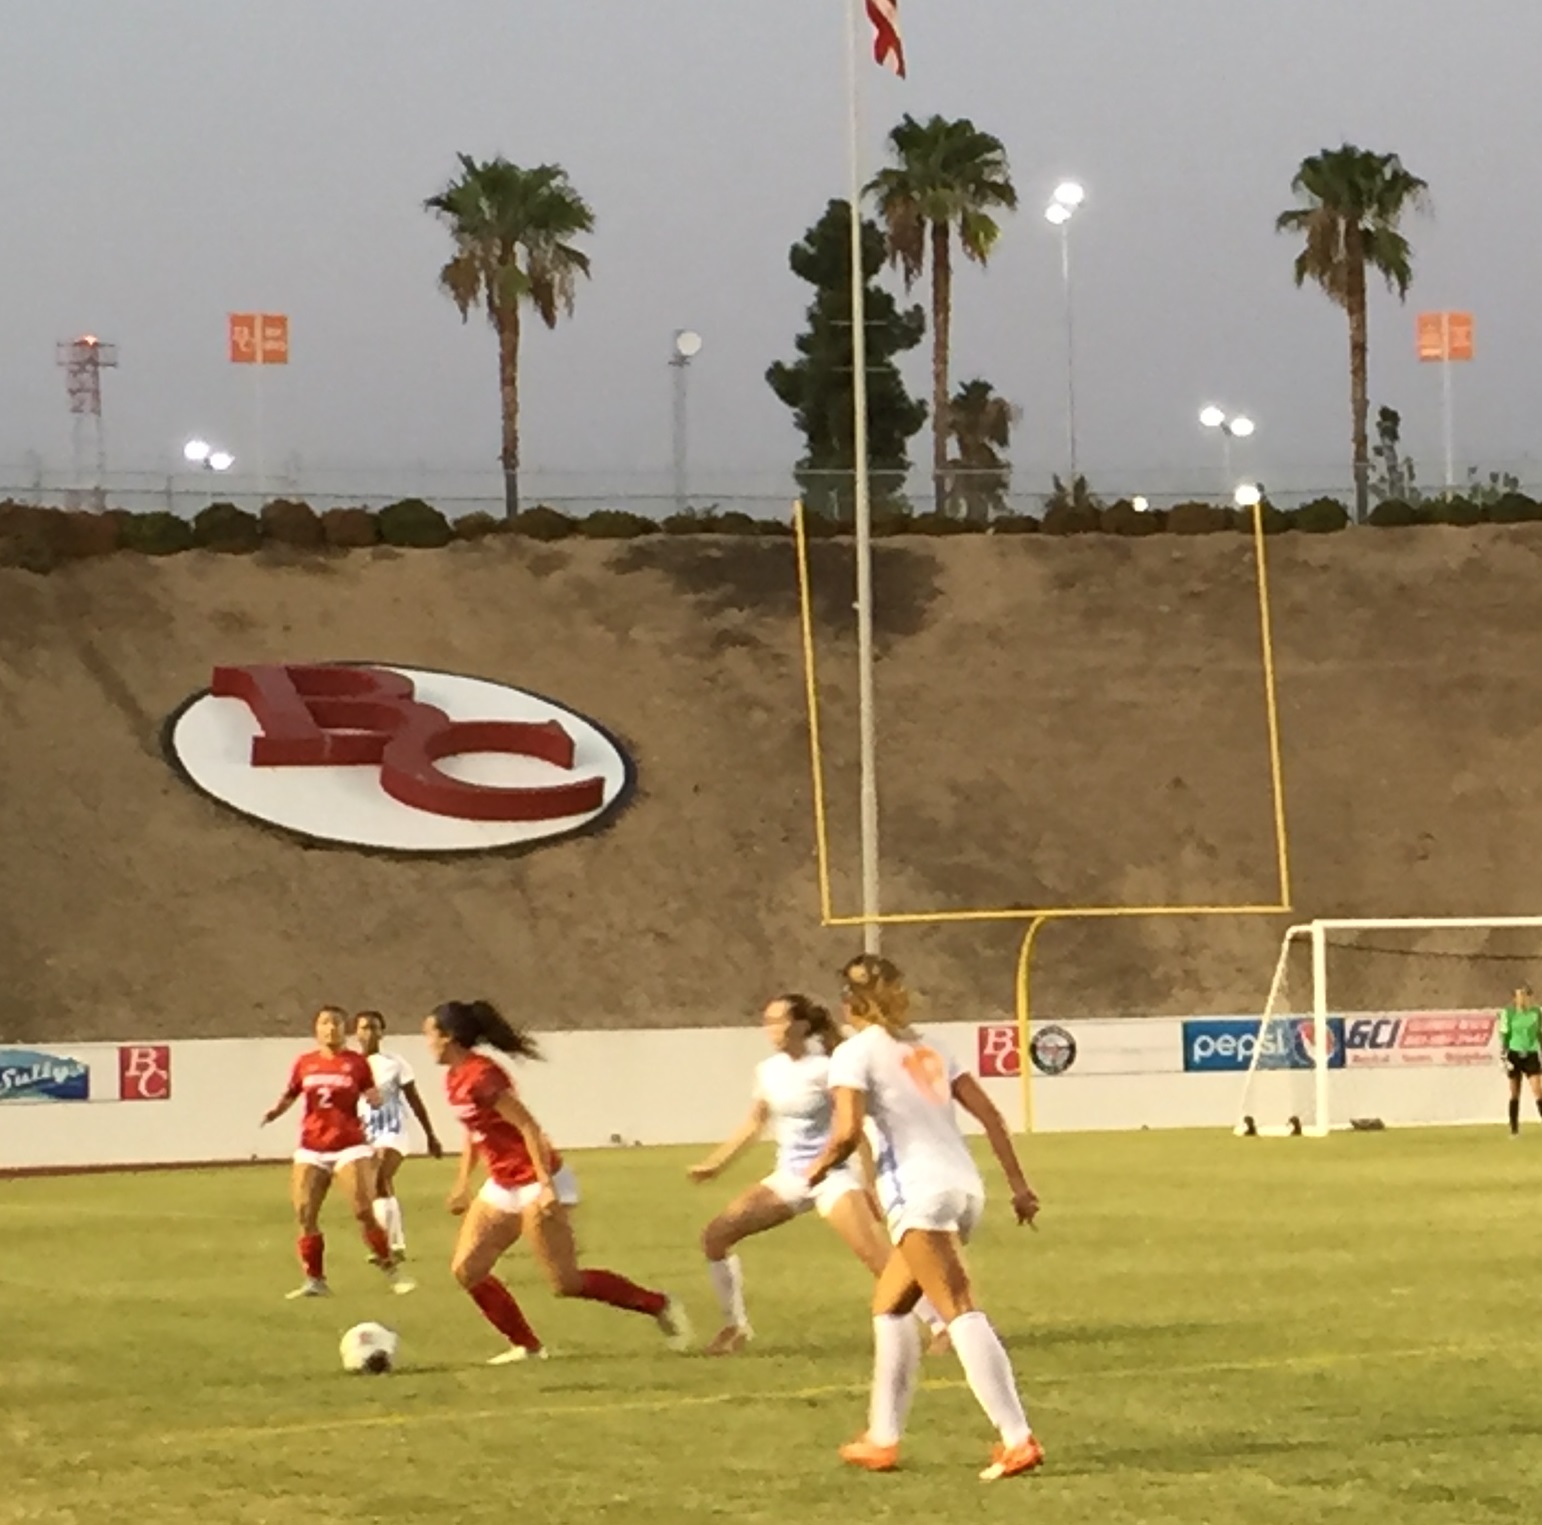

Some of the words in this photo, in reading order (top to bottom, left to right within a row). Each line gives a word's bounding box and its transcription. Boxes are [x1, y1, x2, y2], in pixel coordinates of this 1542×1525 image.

[212, 664, 606, 821] BC
[983, 1027, 1021, 1075] BC
[1193, 1028, 1288, 1064] pepsi
[124, 1047, 168, 1098] BC
[317, 1086, 334, 1109] 2
